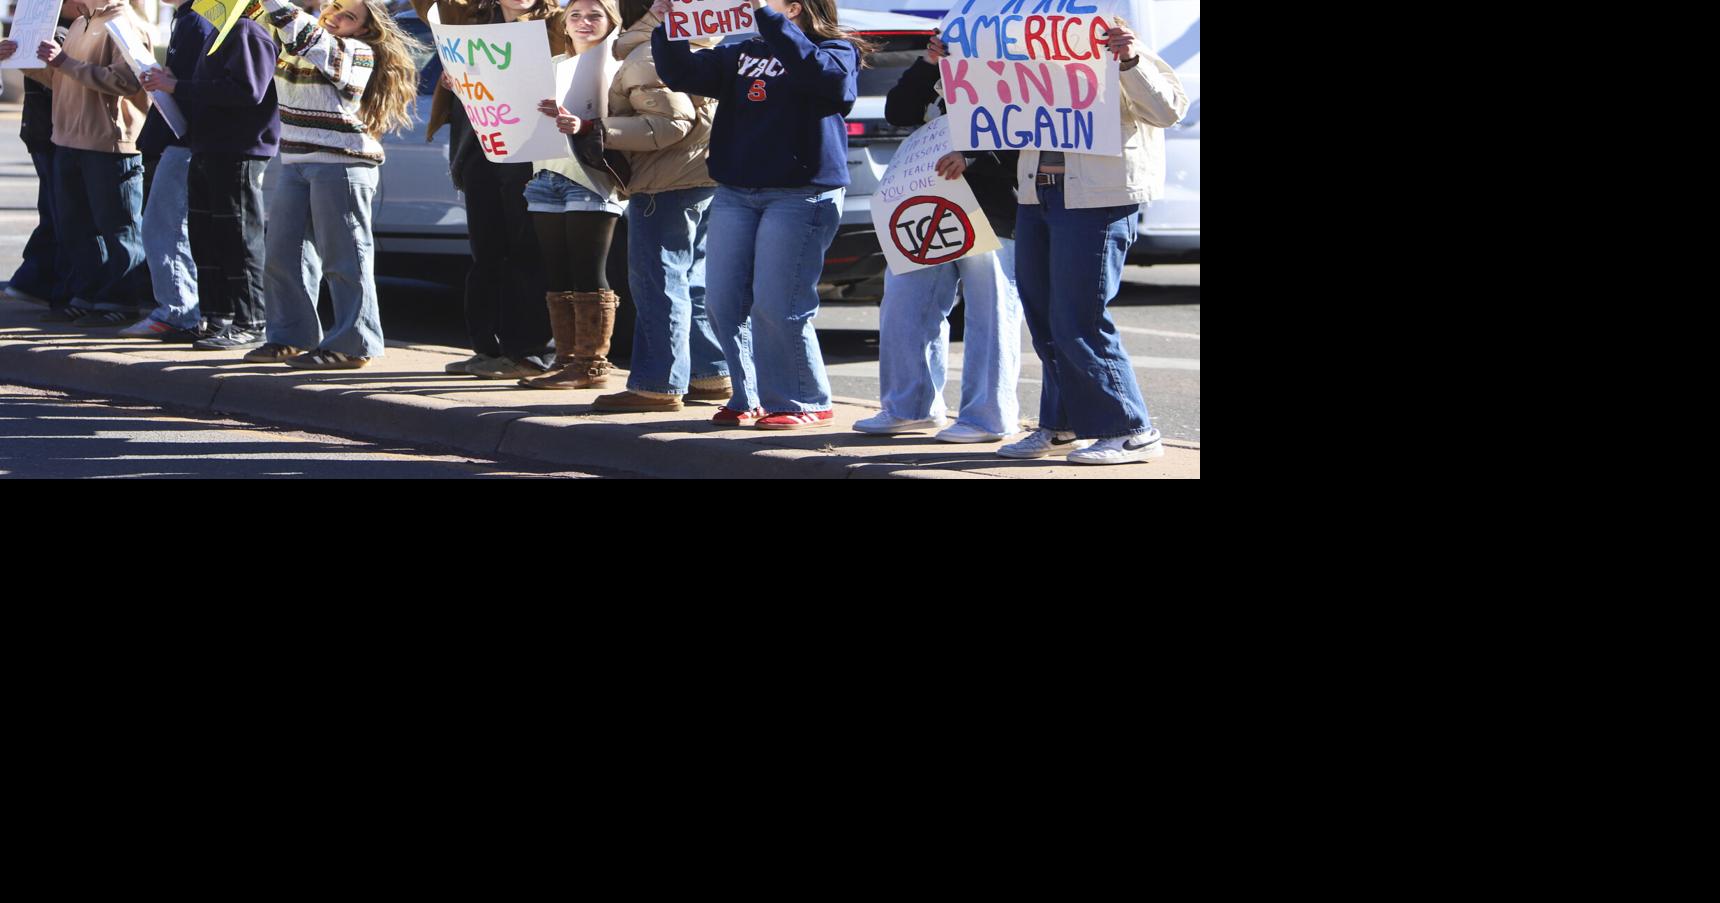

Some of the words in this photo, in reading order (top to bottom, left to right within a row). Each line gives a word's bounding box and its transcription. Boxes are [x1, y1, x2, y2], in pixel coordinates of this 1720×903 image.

[669, 3, 753, 38] RIGHTS
[941, 14, 1119, 61] AMERICA
[467, 38, 511, 70] My
[747, 79, 767, 102] S
[970, 104, 1093, 150] AGAIN
[475, 131, 508, 155] CE
[904, 143, 949, 165] LESSONS
[903, 161, 935, 178] TEACH
[881, 185, 904, 201] YOU
[909, 175, 937, 192] ONE
[896, 212, 962, 255] ICE
